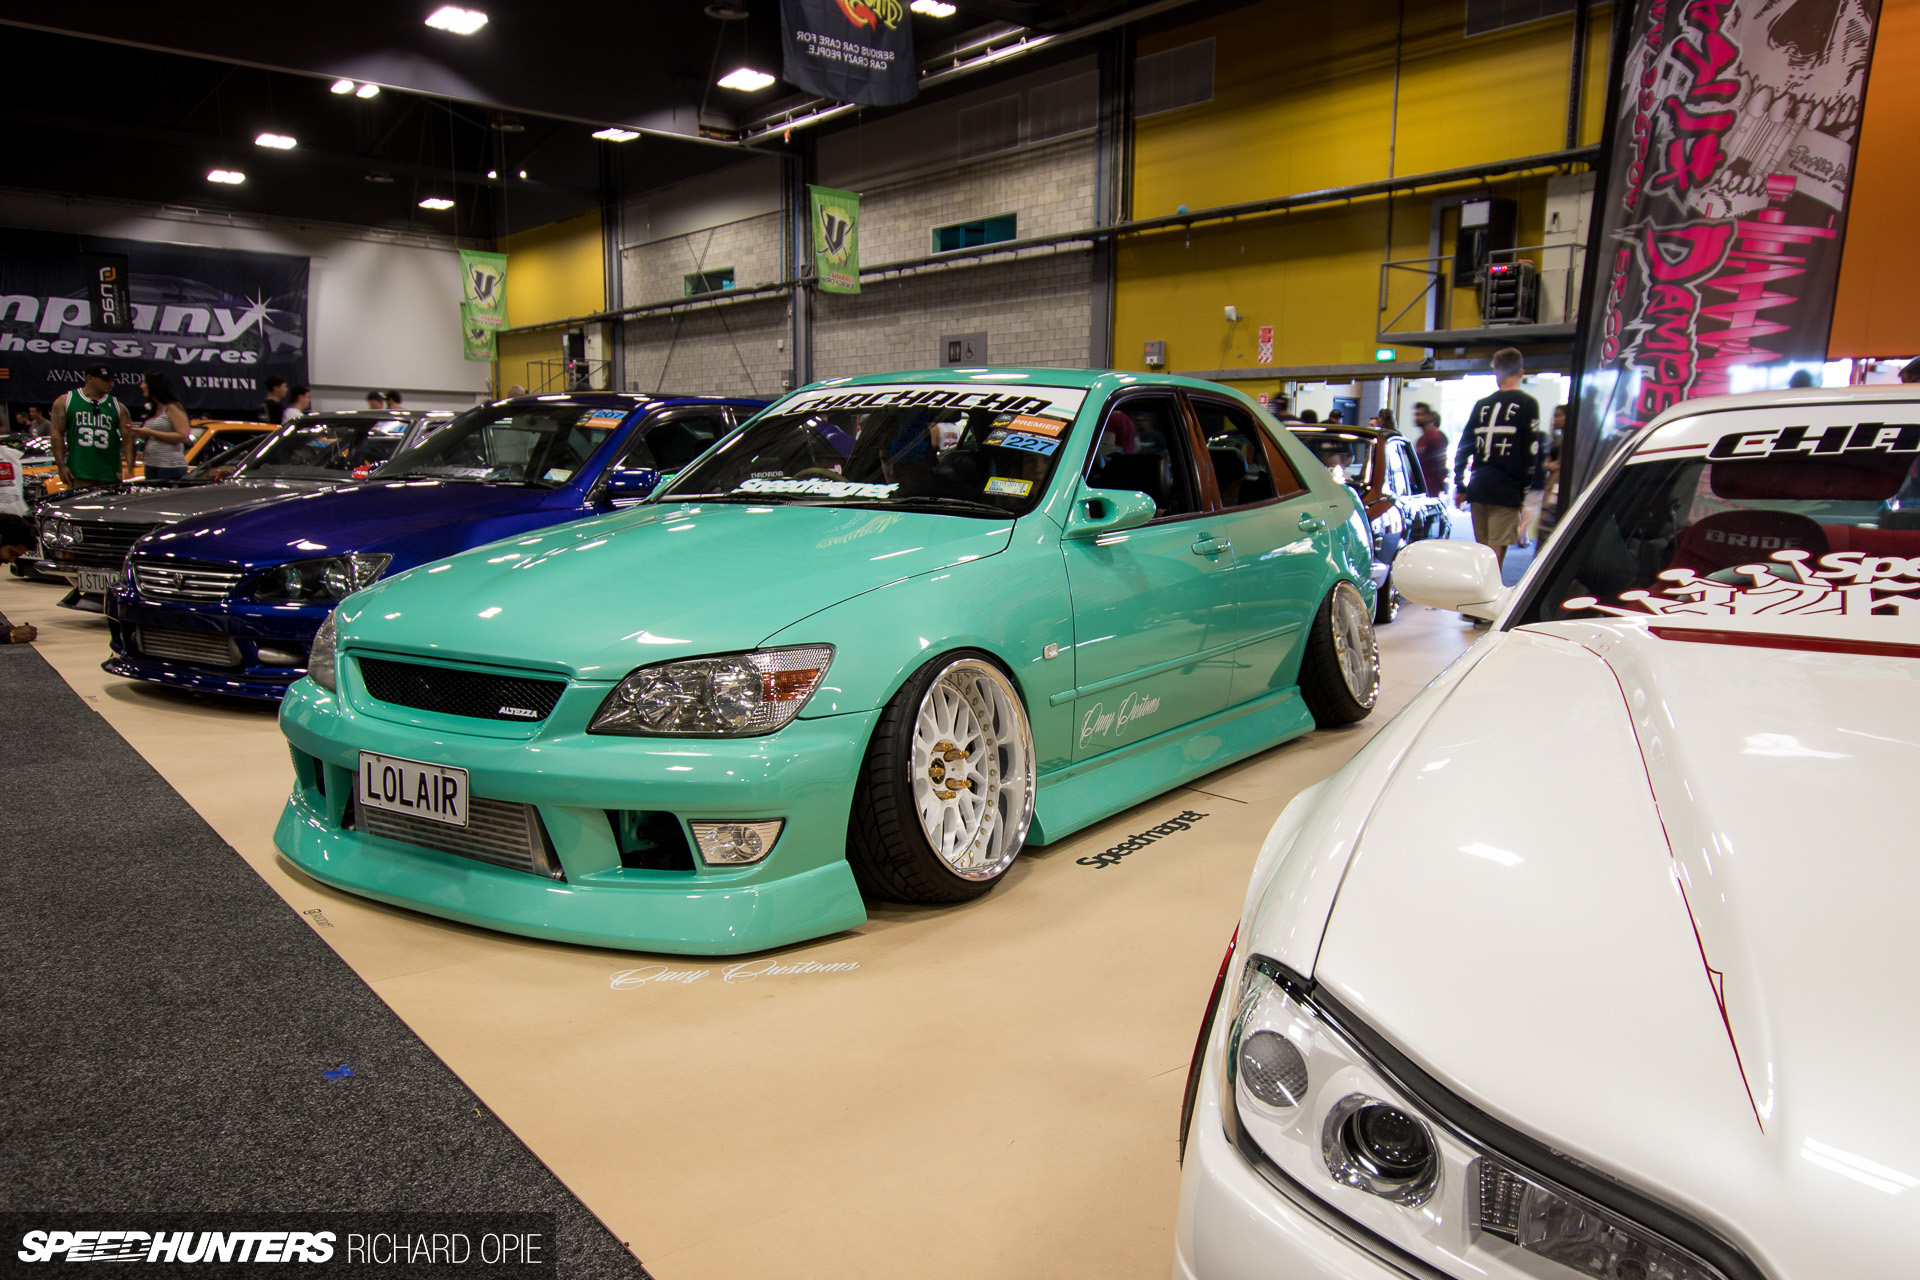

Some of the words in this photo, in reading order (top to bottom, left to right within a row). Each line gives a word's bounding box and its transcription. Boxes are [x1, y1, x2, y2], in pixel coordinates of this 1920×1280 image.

[0, 333, 107, 355] heels
[111, 339, 143, 358] &
[151, 342, 258, 365] Tyres
[183, 375, 258, 390] VERTINI
[1012, 419, 1060, 432] PREMIER
[78, 427, 109, 449] 33
[1005, 436, 1055, 452] 227
[730, 477, 900, 499] Speedmagnet
[1704, 528, 1804, 550] BRIDE
[498, 705, 538, 719] ALTEZZA
[366, 761, 459, 817] LOLAIR
[1075, 809, 1211, 870] Speedmagnet
[721, 959, 861, 985] Customs
